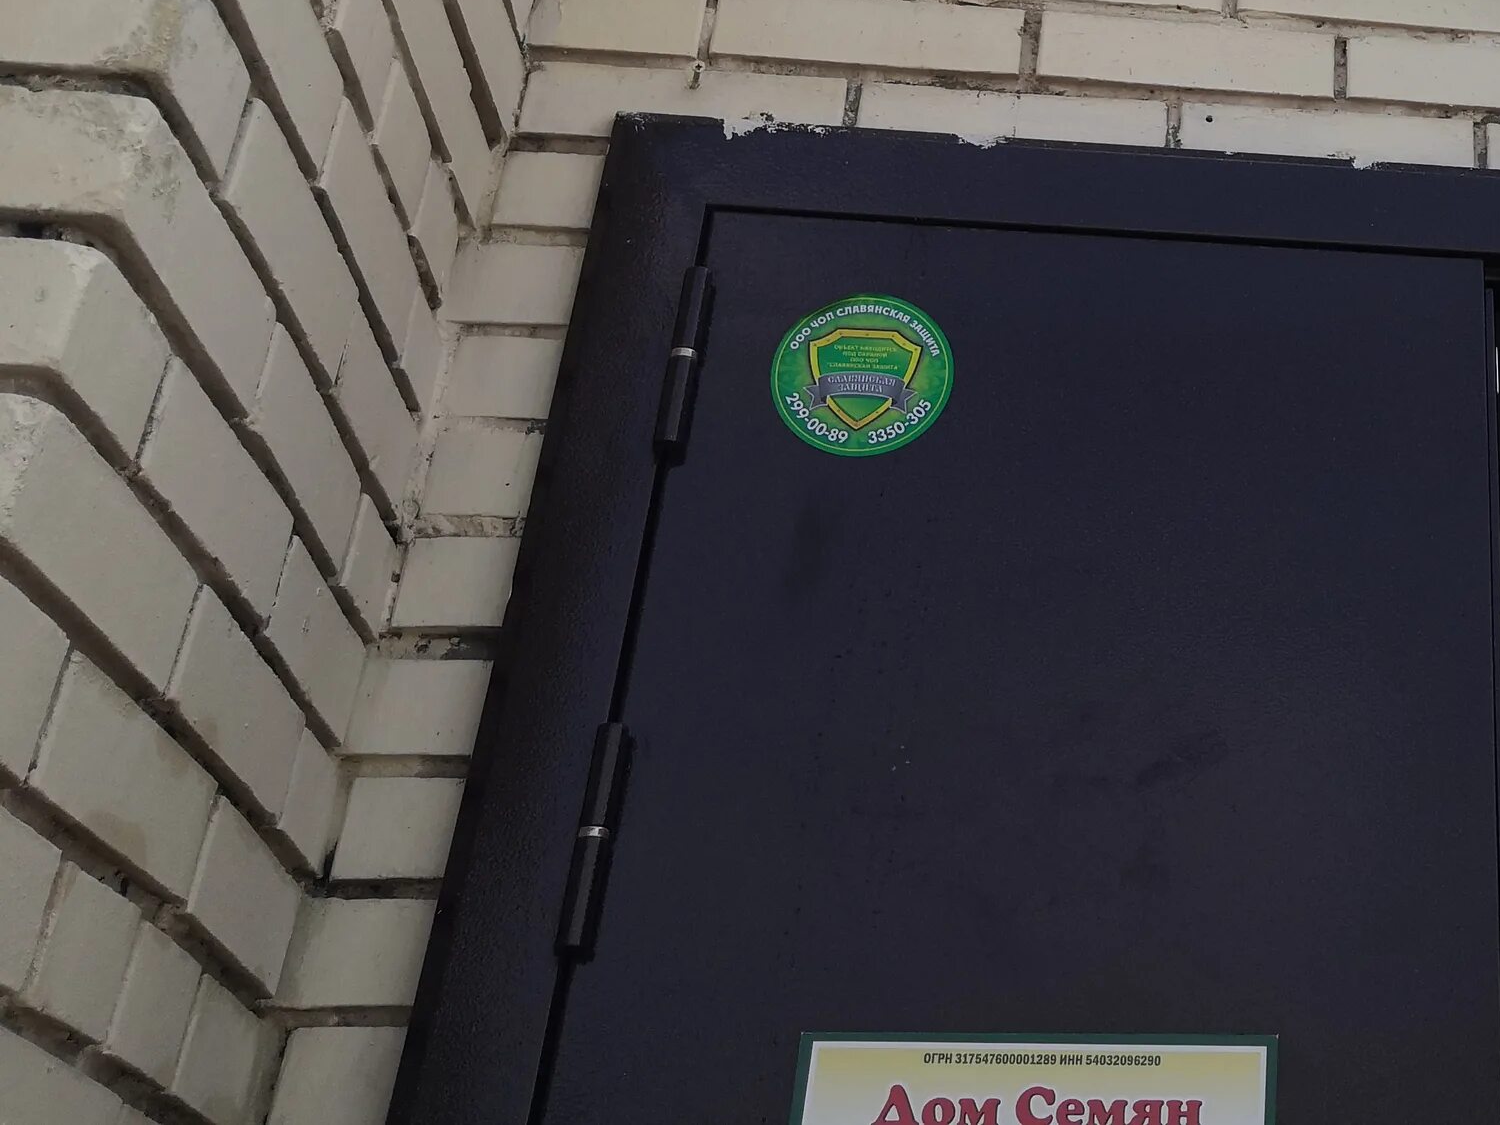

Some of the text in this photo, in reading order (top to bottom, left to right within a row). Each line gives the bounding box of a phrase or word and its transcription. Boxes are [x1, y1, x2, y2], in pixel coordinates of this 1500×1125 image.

[790, 304, 941, 358] ООО ЧОП СЛАВЯНСКАЯ ЗАЩИТА
[837, 383, 884, 394] ЗАЩИТА
[785, 392, 849, 444] 299-00-89
[867, 399, 932, 445] 3350-305
[923, 1052, 1162, 1066] ОГРН 317547600001289 ИНН 54032096290
[870, 1084, 1203, 1125] Дом Семян
